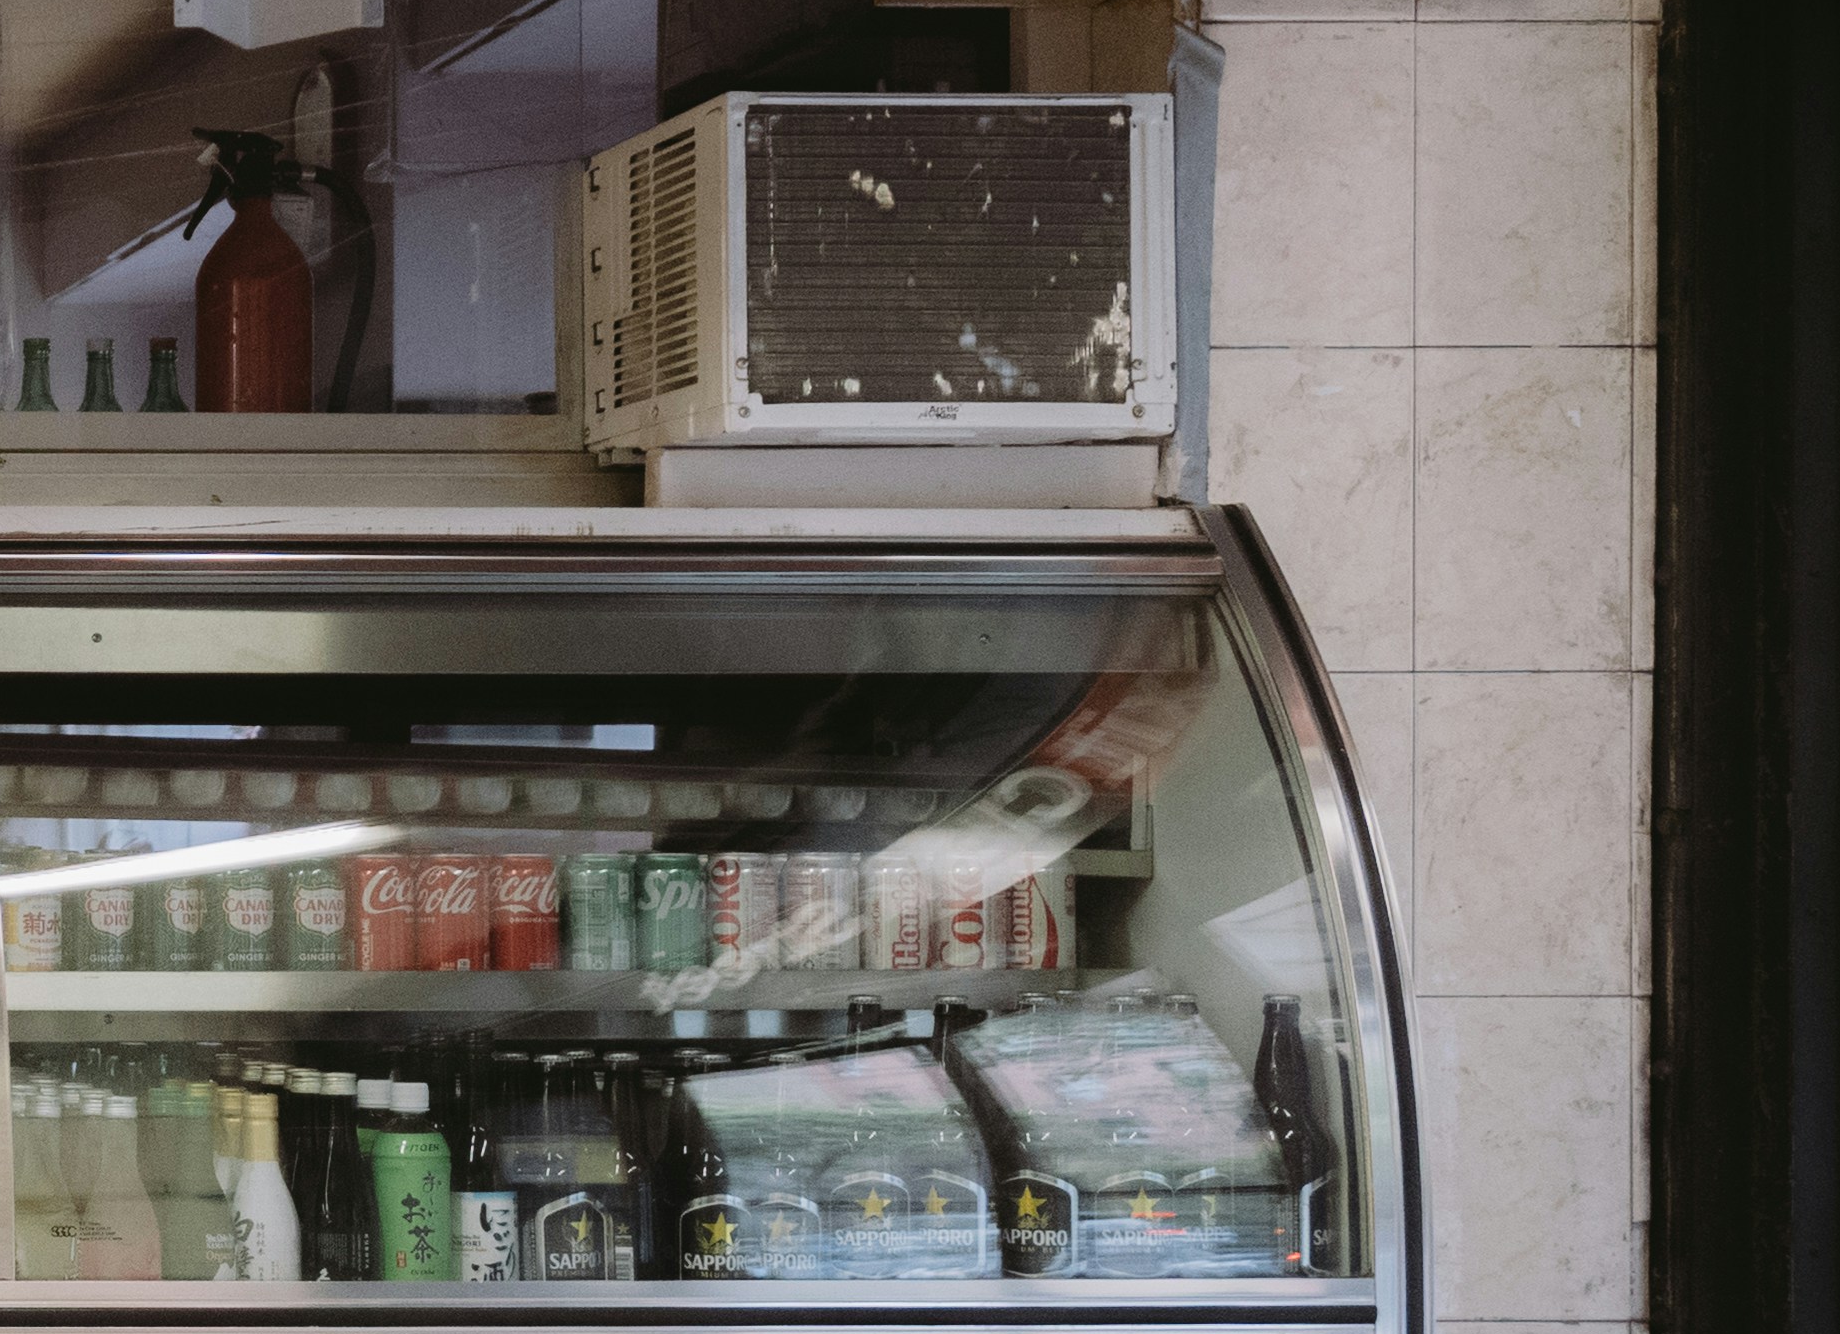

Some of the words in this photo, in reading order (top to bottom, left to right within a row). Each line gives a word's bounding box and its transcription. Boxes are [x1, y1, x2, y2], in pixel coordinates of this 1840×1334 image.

[241, 912, 270, 925] DRY
[312, 913, 342, 925] DRY
[227, 953, 264, 962] GINGER
[299, 952, 336, 962] GINGER
[401, 1192, 440, 1264] お茶
[1002, 1228, 1068, 1247] APPORO
